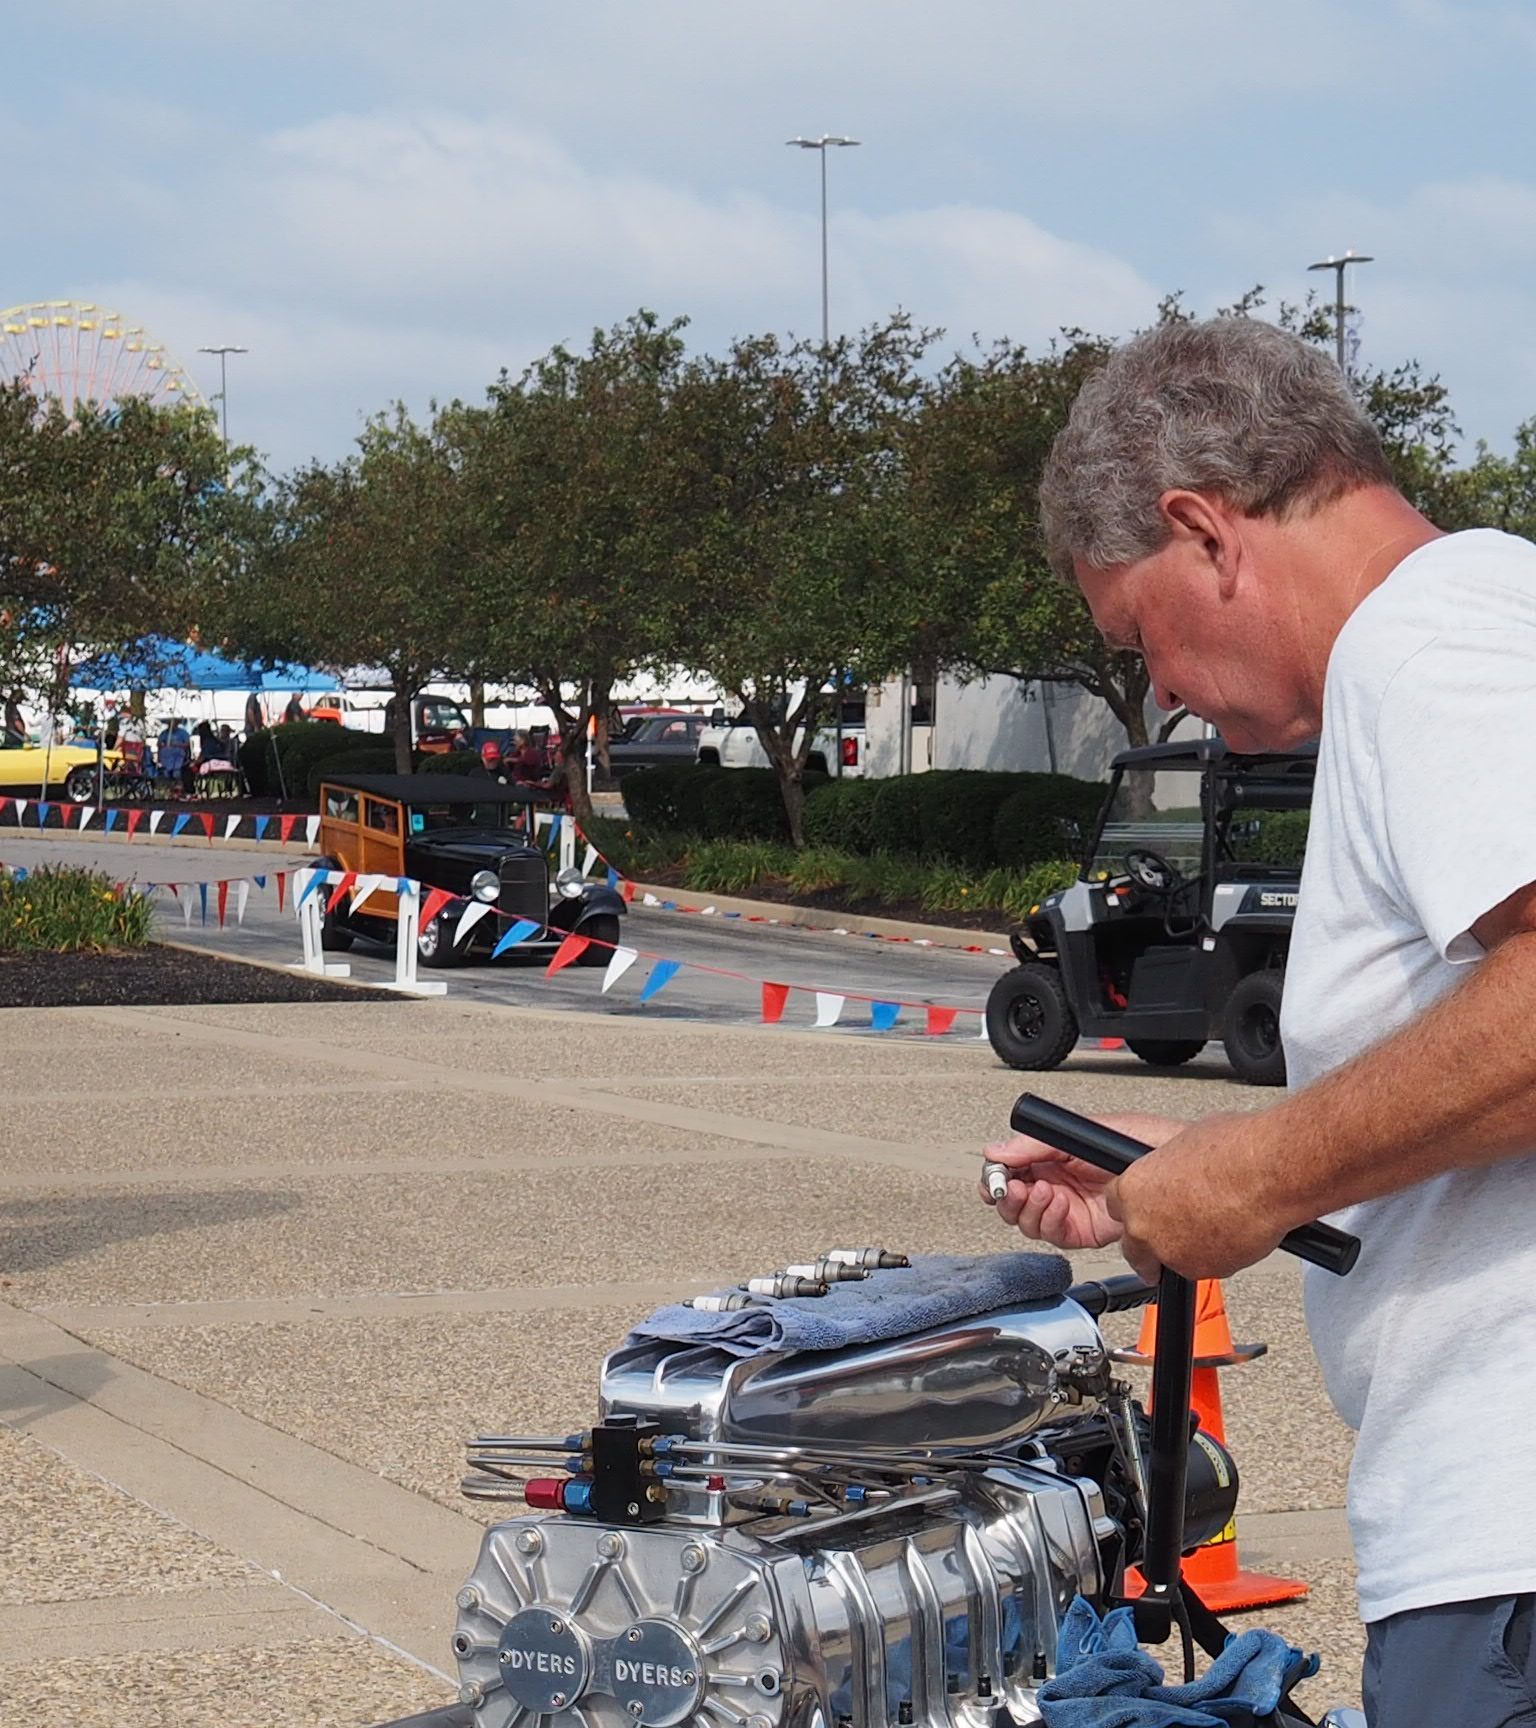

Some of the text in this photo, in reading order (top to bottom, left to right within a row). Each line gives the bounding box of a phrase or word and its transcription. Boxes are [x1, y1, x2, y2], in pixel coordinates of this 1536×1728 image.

[1260, 892, 1297, 907] SECTO
[509, 1647, 576, 1676] DYERS
[615, 1658, 683, 1688] DYERS
